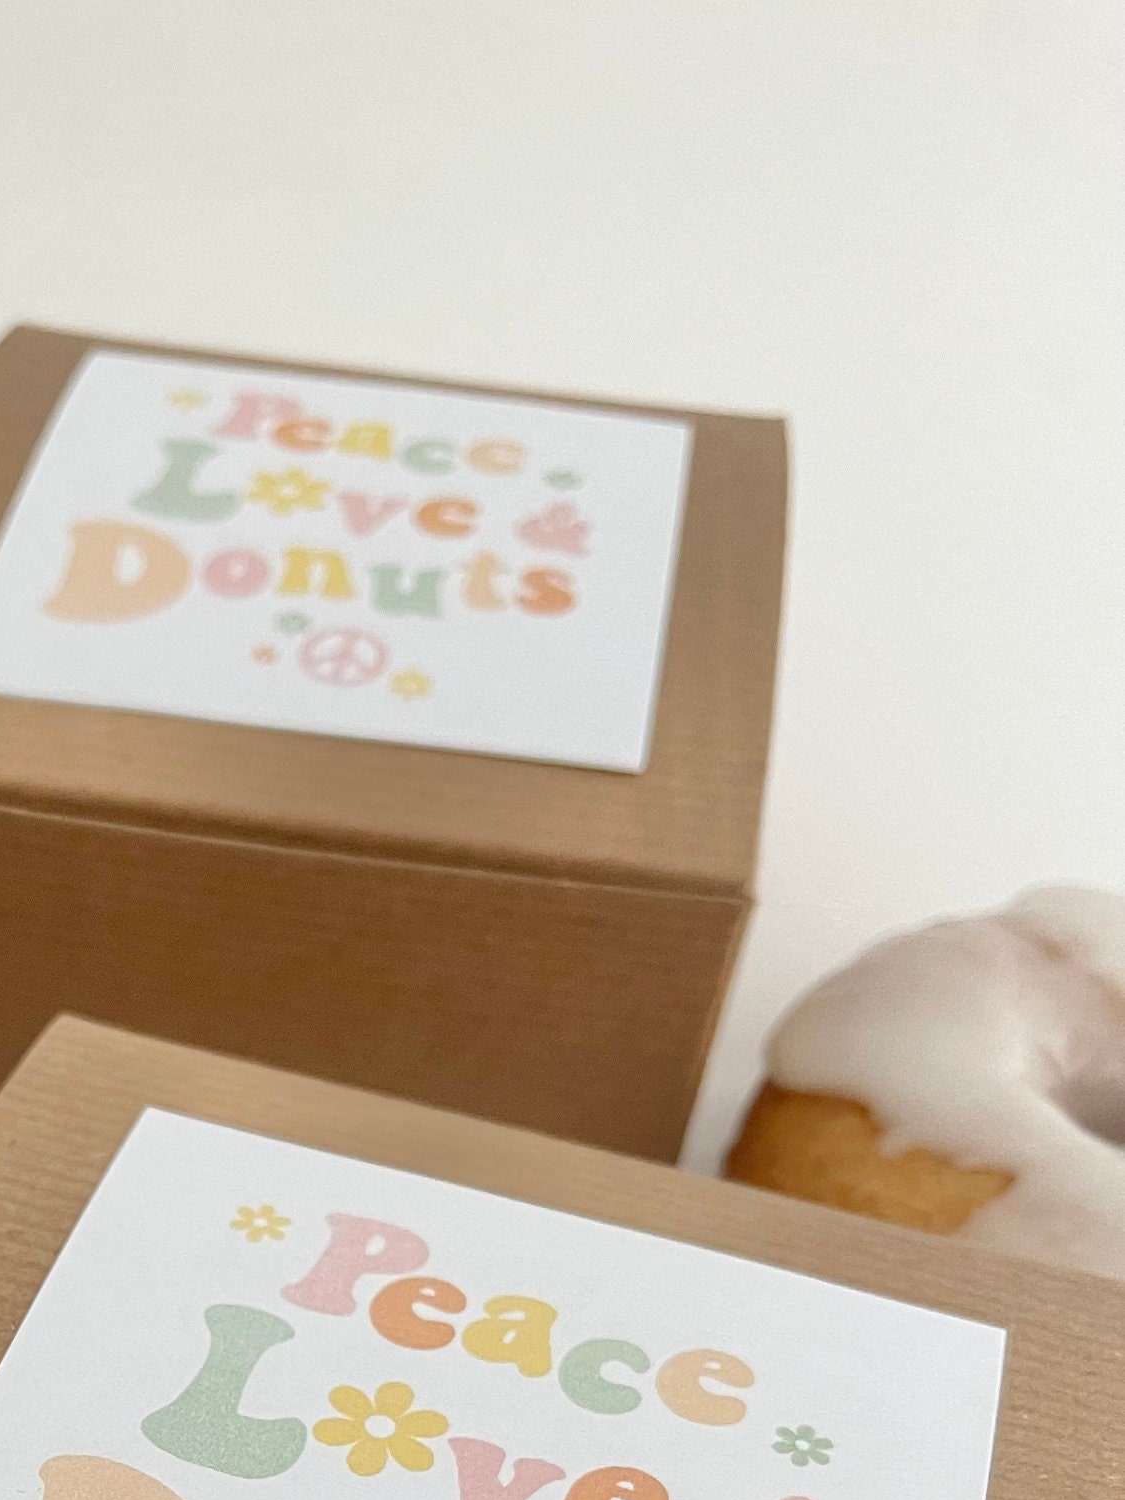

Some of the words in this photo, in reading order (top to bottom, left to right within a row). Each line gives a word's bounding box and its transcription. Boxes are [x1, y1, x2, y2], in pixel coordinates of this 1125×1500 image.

[215, 389, 528, 474] Peace
[41, 517, 578, 624] Donuts
[516, 500, 592, 556] &
[281, 1211, 756, 1427] Peace
